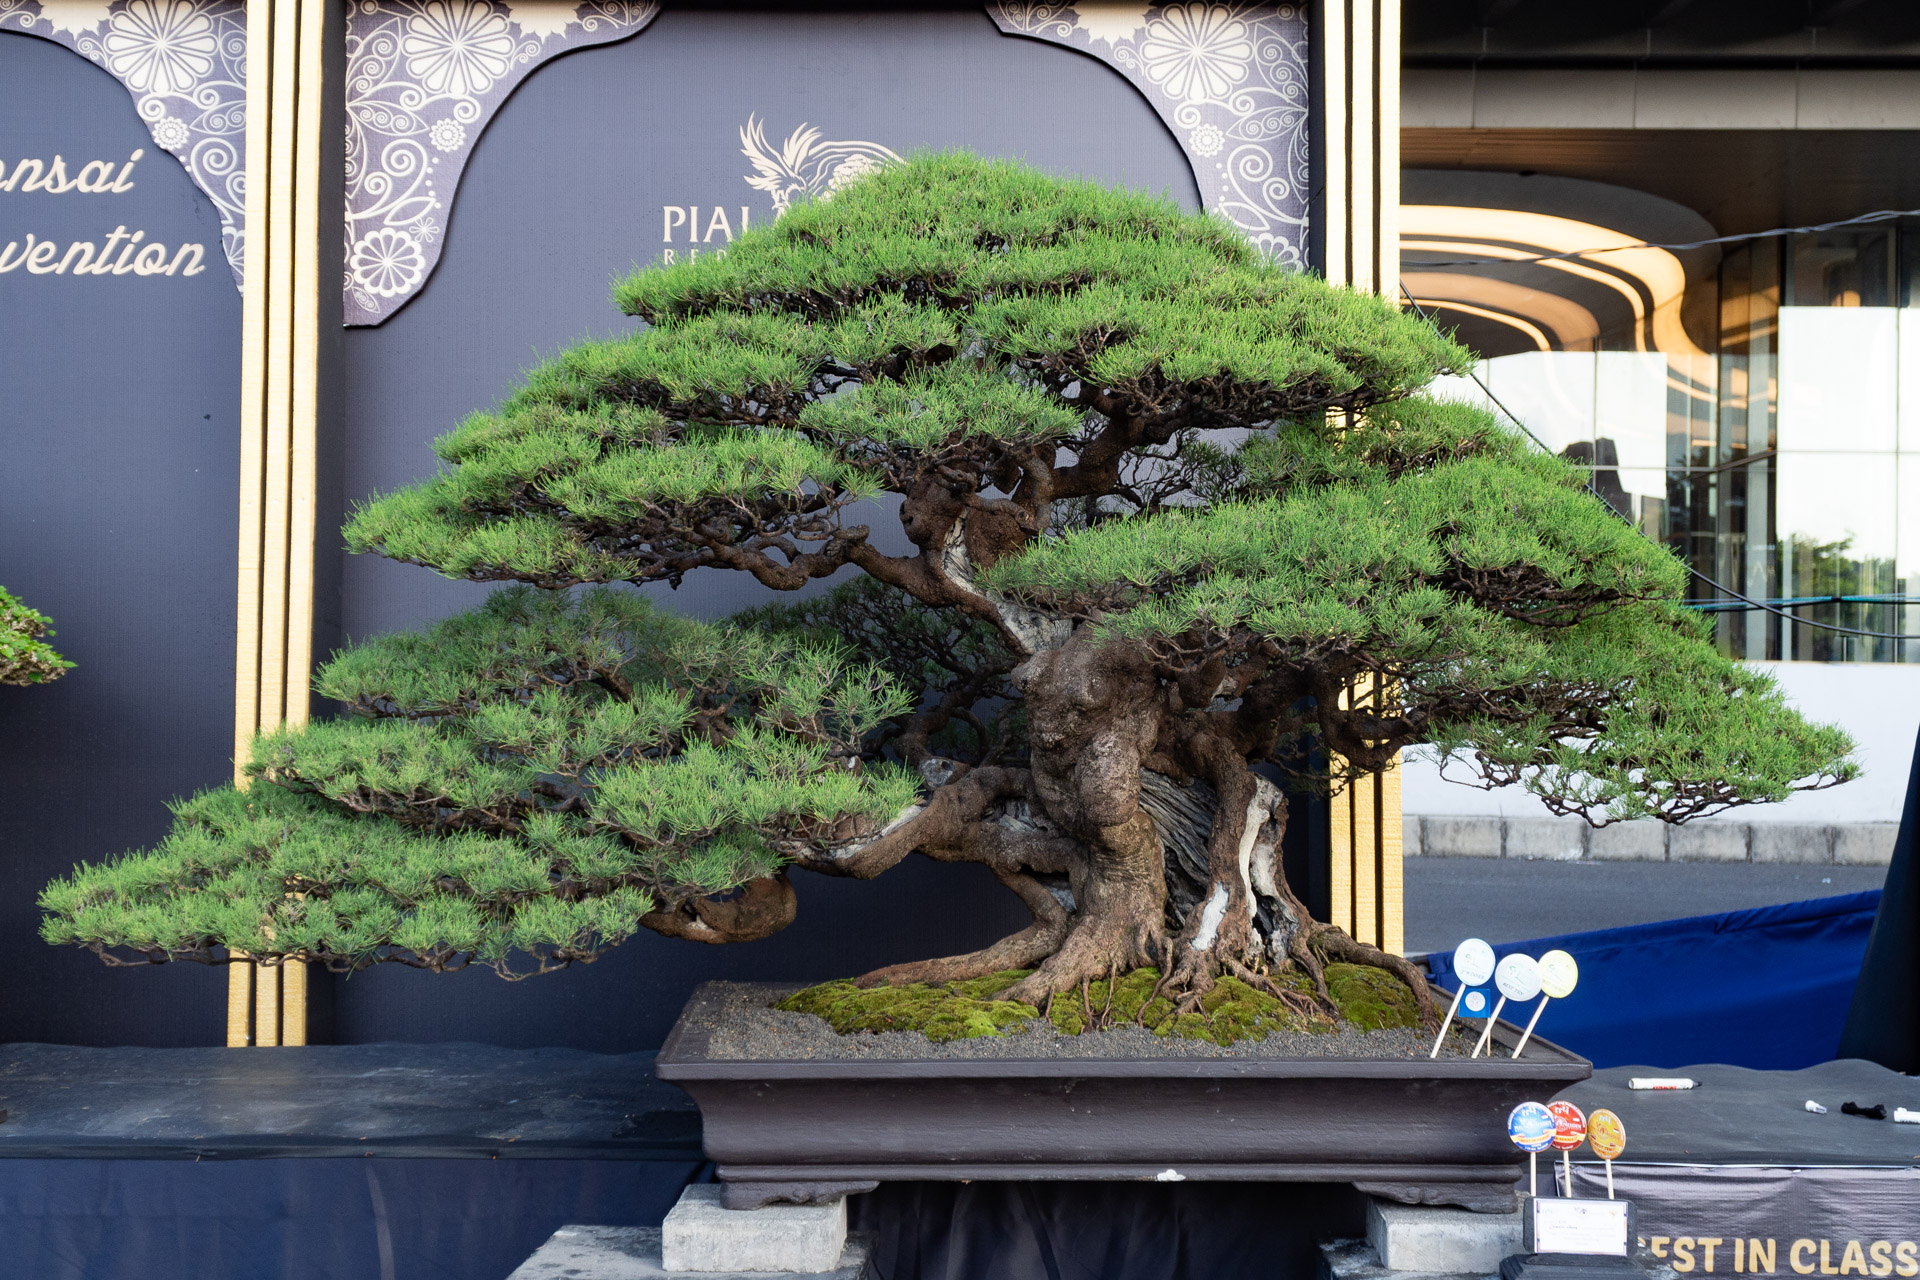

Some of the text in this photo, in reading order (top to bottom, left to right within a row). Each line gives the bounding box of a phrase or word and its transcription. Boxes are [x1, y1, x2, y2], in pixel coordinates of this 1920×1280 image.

[0, 149, 144, 193] nsai
[1638, 1236, 1919, 1277] EST IN CLASS
